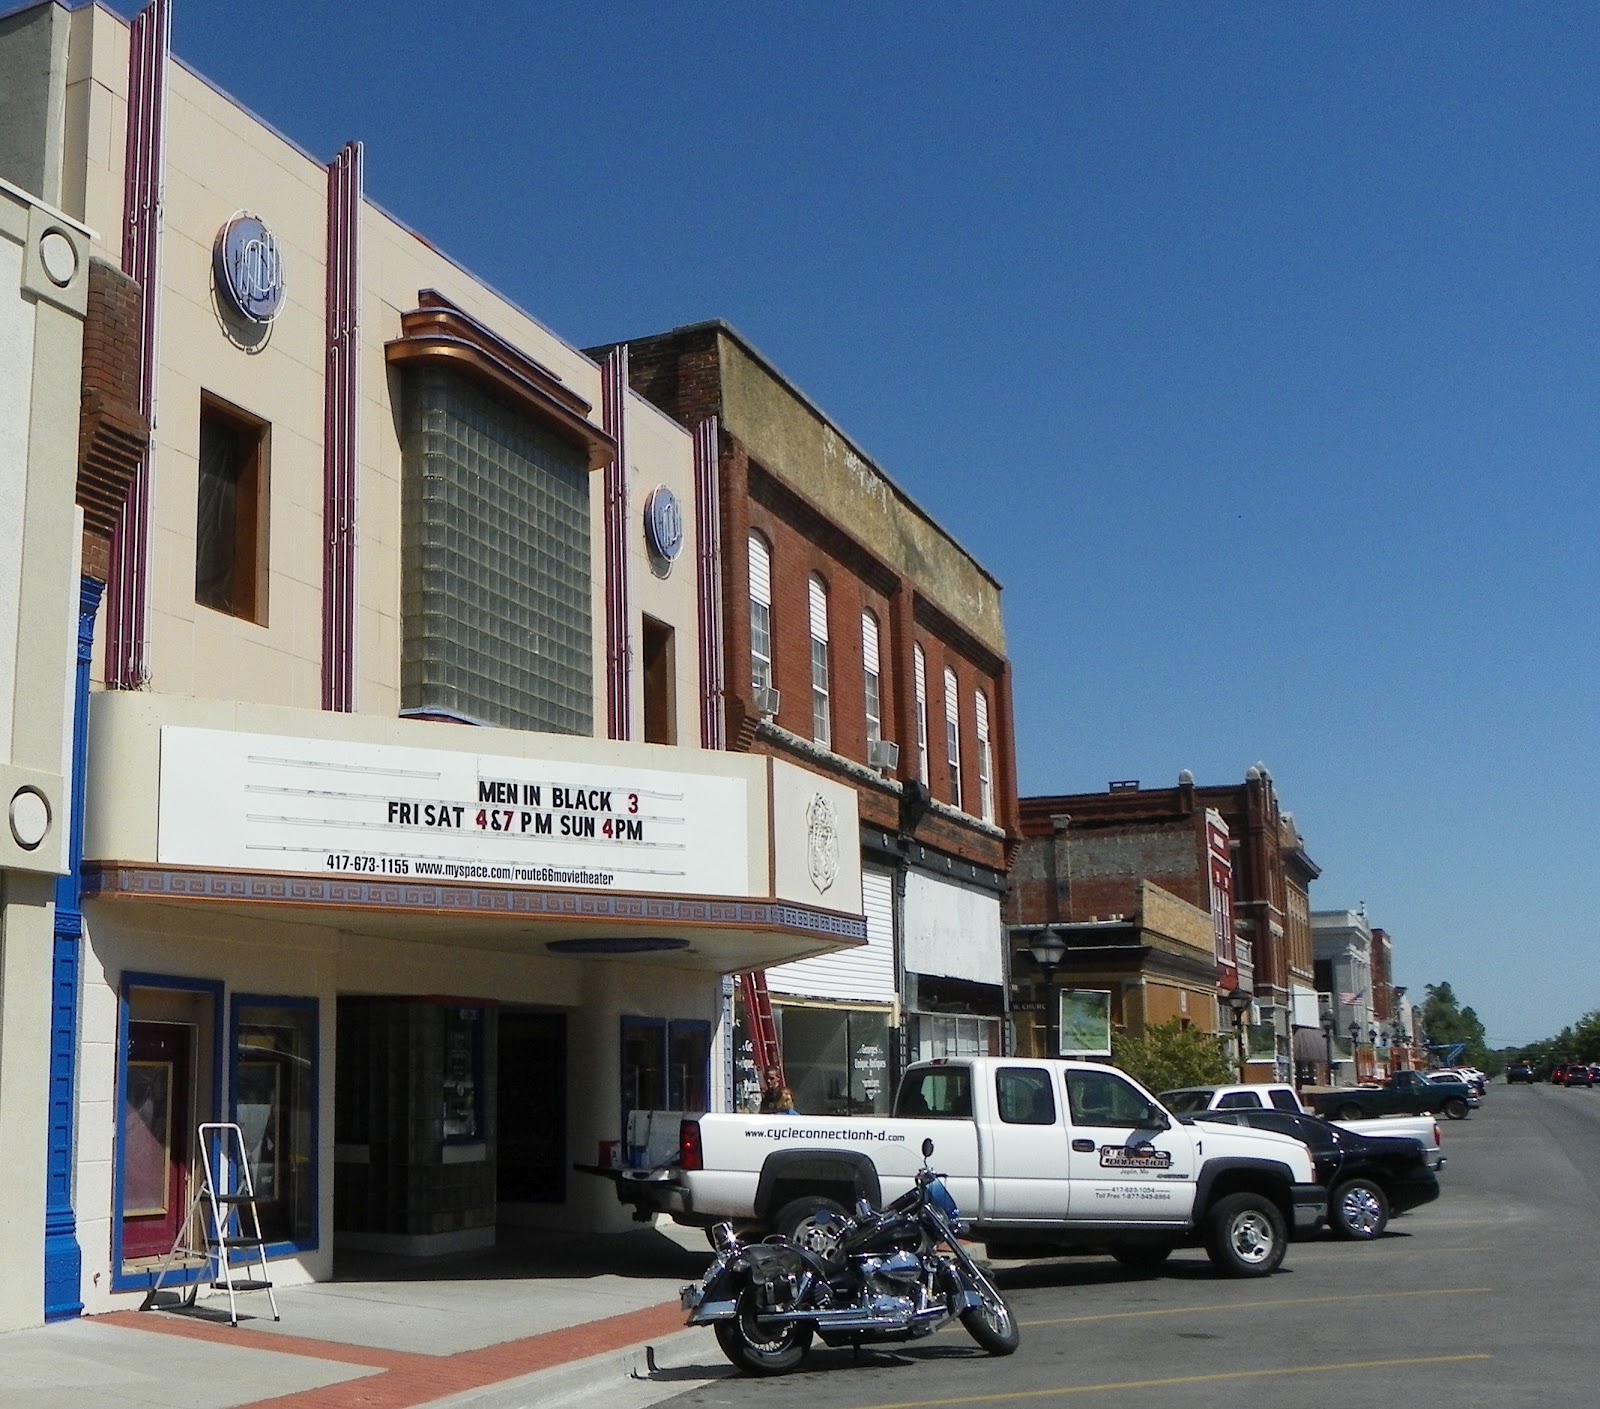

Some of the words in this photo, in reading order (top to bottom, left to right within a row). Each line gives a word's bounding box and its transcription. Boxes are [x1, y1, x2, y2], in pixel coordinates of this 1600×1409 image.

[479, 781, 518, 806] MEN
[523, 784, 541, 806] IN
[552, 788, 612, 812] BLACK
[628, 793, 640, 814] 3
[476, 809, 514, 832] 4&7
[521, 812, 552, 835] PM
[561, 814, 595, 838] SUN
[602, 819, 643, 841] 4PM
[326, 854, 409, 875] 417-673-1155
[415, 862, 614, 886] www.myspace.com/route66movietheater
[744, 1127, 905, 1142] www.cycleconnectionh-d.com
[1196, 1140, 1203, 1155] 1
